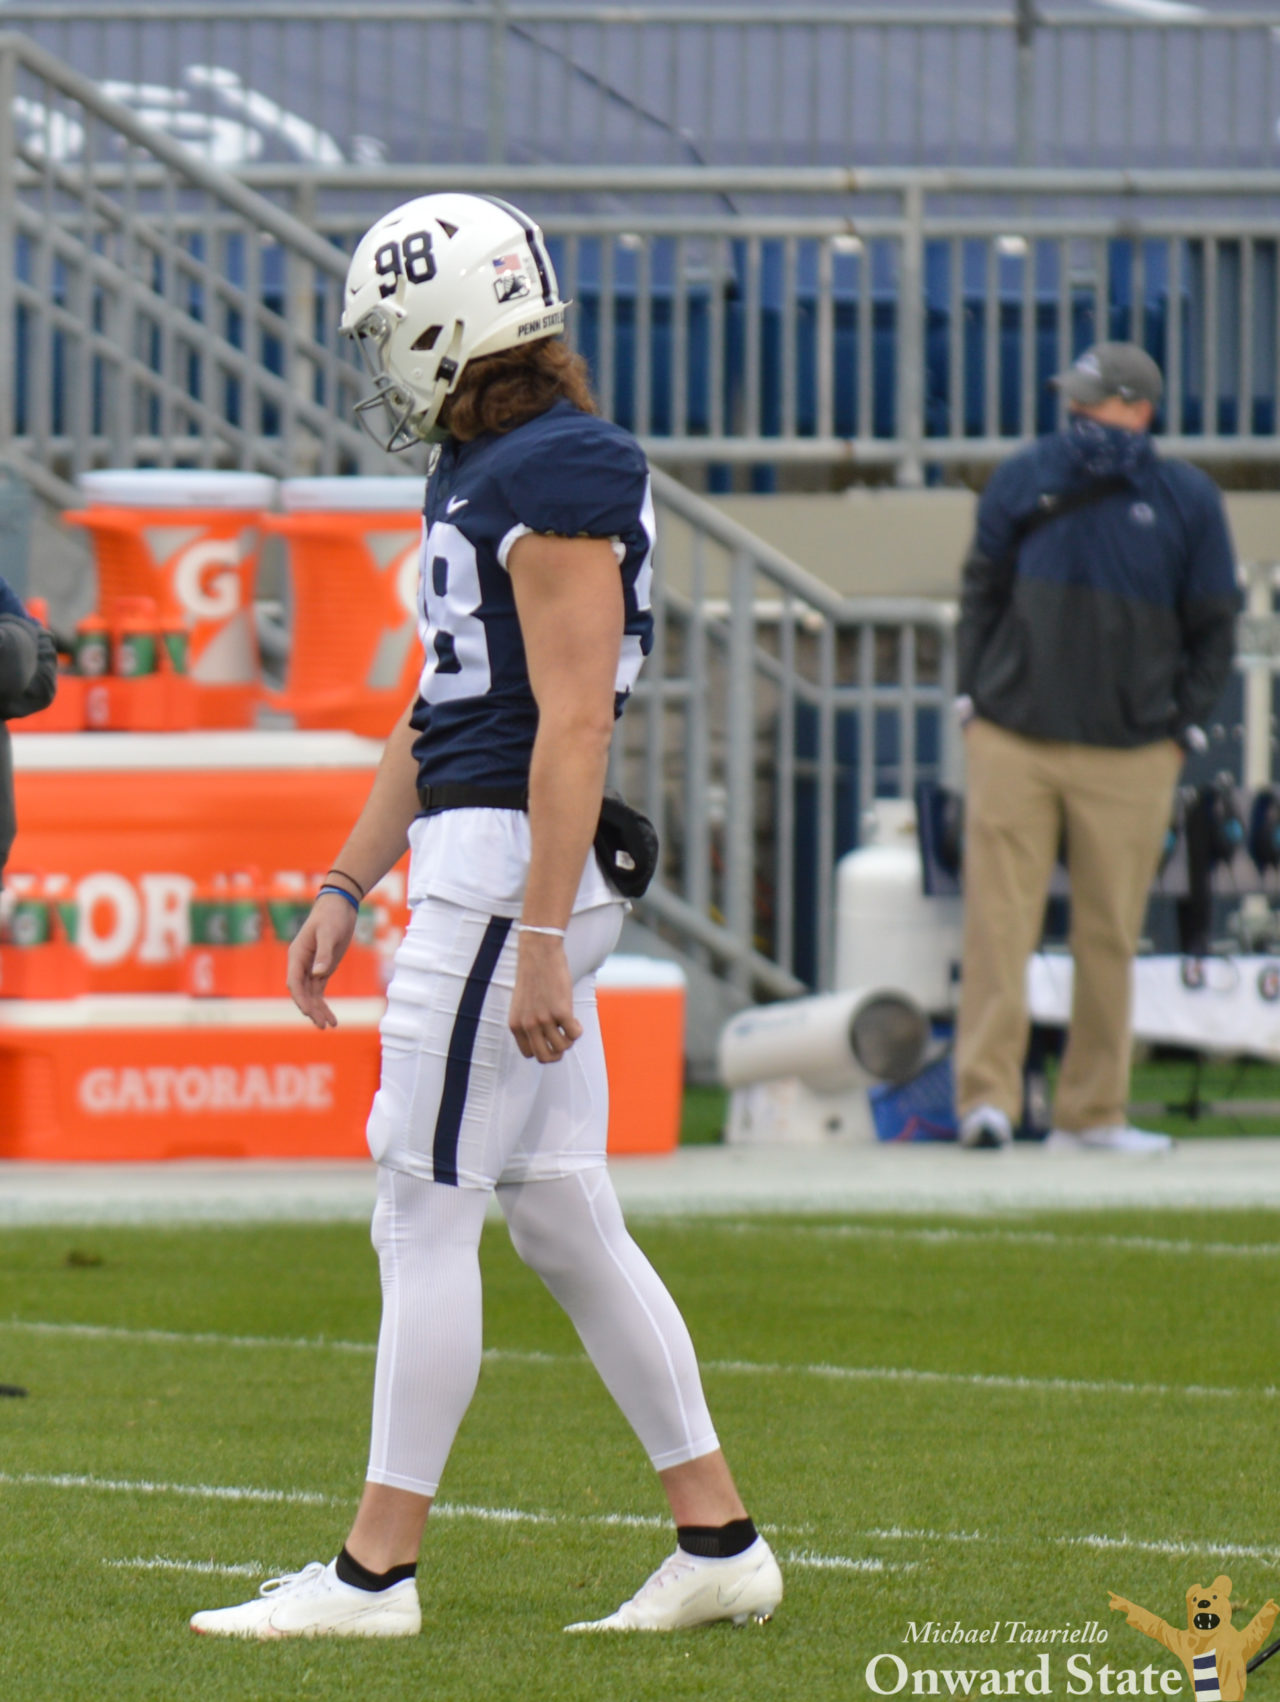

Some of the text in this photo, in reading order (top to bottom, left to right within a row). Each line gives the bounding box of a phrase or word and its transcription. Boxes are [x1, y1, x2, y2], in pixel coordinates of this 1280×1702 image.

[374, 229, 437, 299] 98
[517, 319, 541, 338] PENN
[174, 538, 241, 619] G
[77, 1062, 336, 1115] GATORADE
